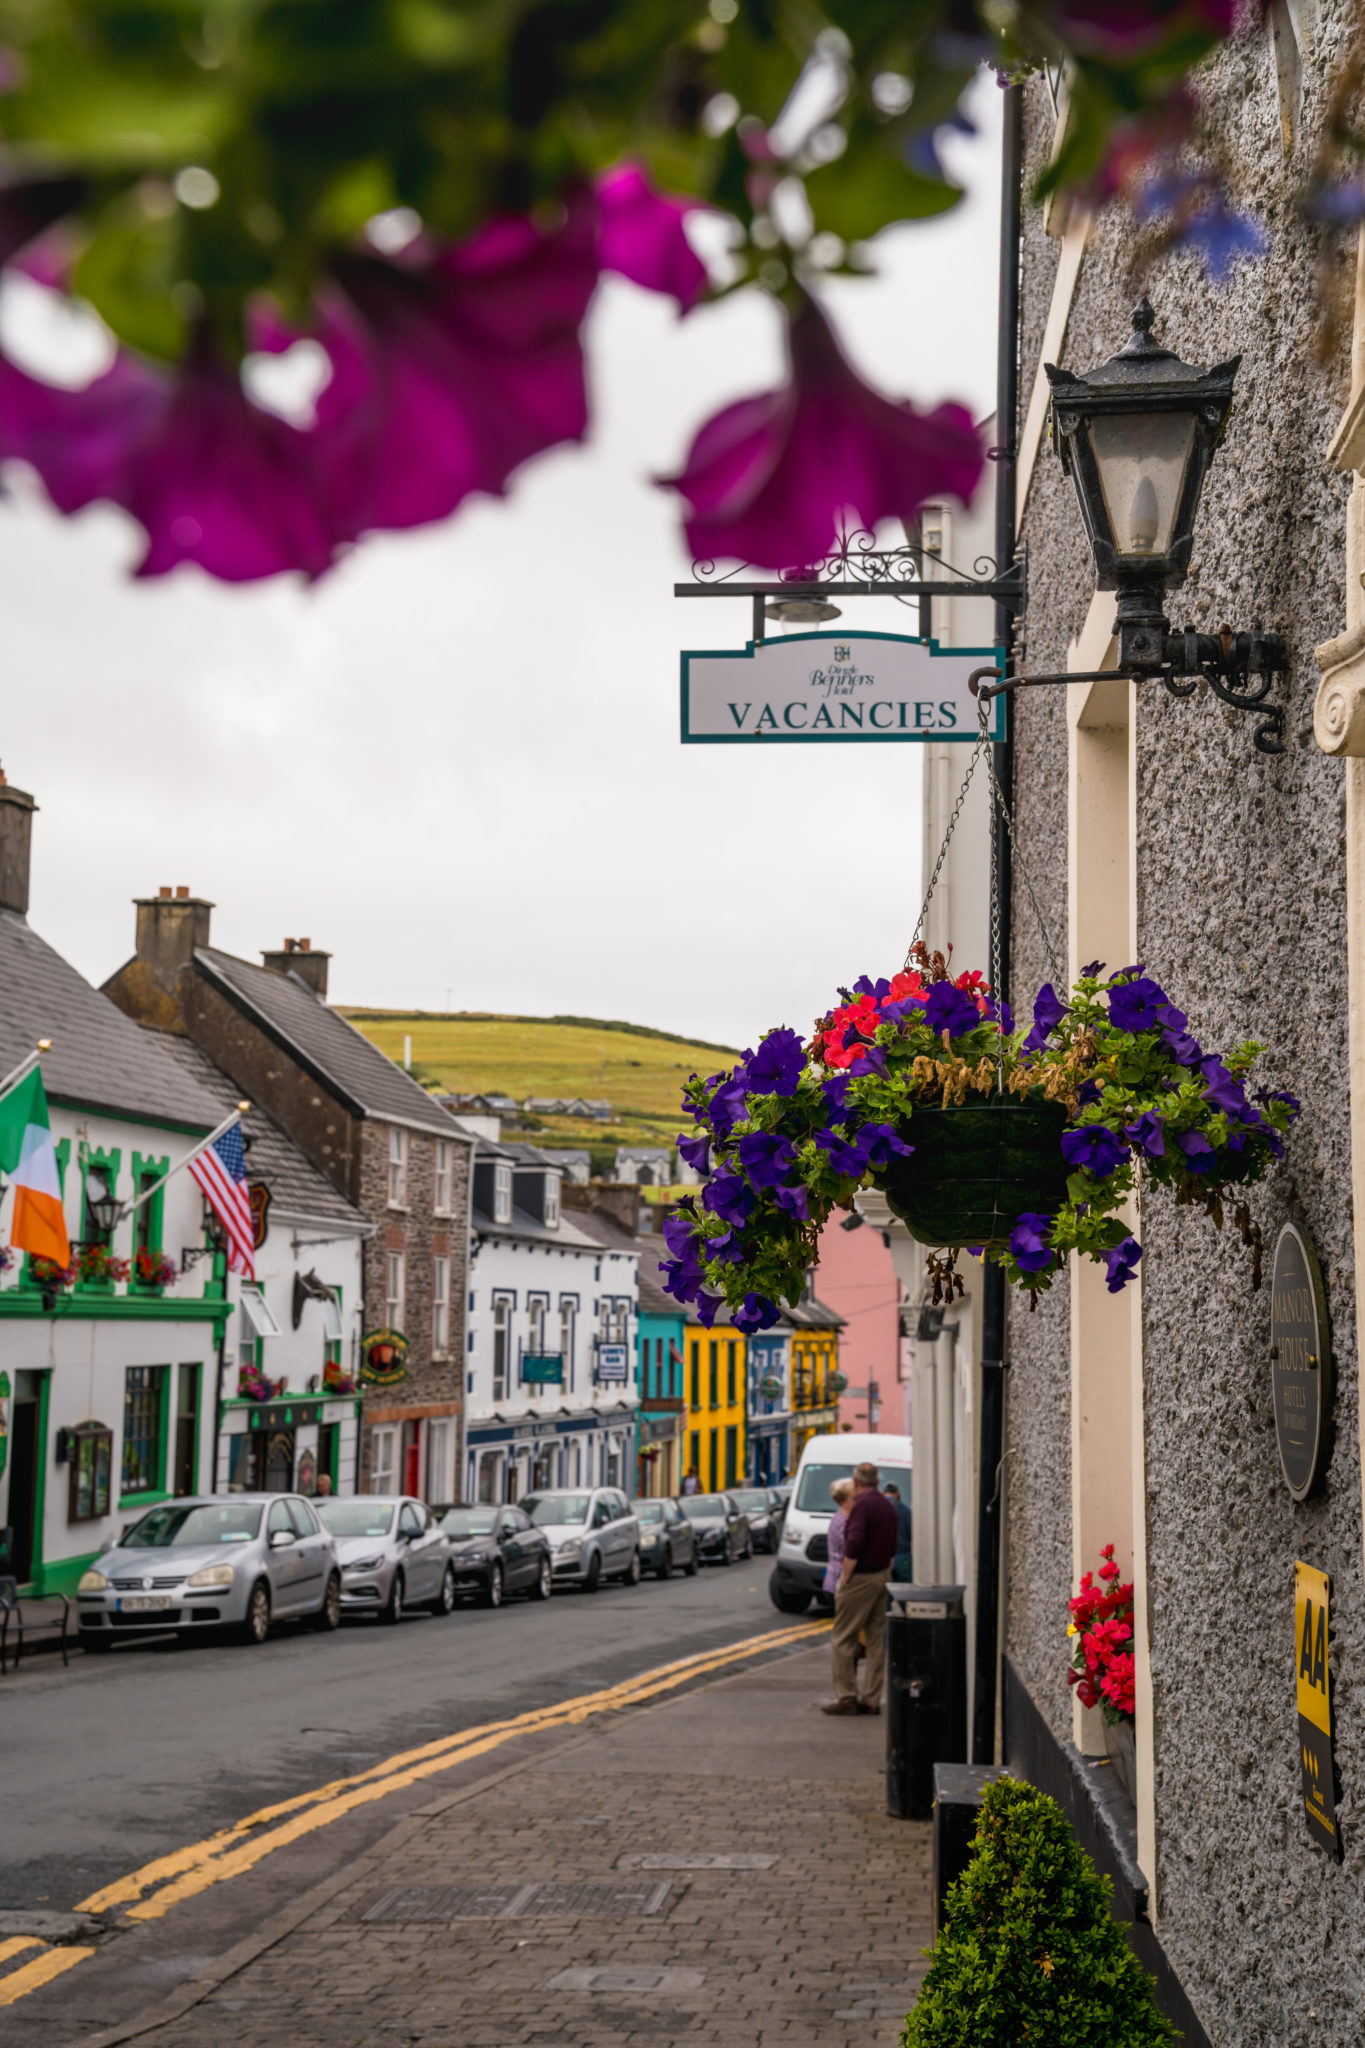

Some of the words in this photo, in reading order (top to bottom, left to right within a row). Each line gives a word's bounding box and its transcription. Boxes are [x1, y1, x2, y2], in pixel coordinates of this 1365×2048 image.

[727, 701, 957, 728] VACANCIES
[1274, 1288, 1312, 1323] MANOR
[1278, 1337, 1310, 1371] HOUSE
[1283, 1385, 1307, 1408] HOTELS
[1299, 1598, 1326, 1696] AA
